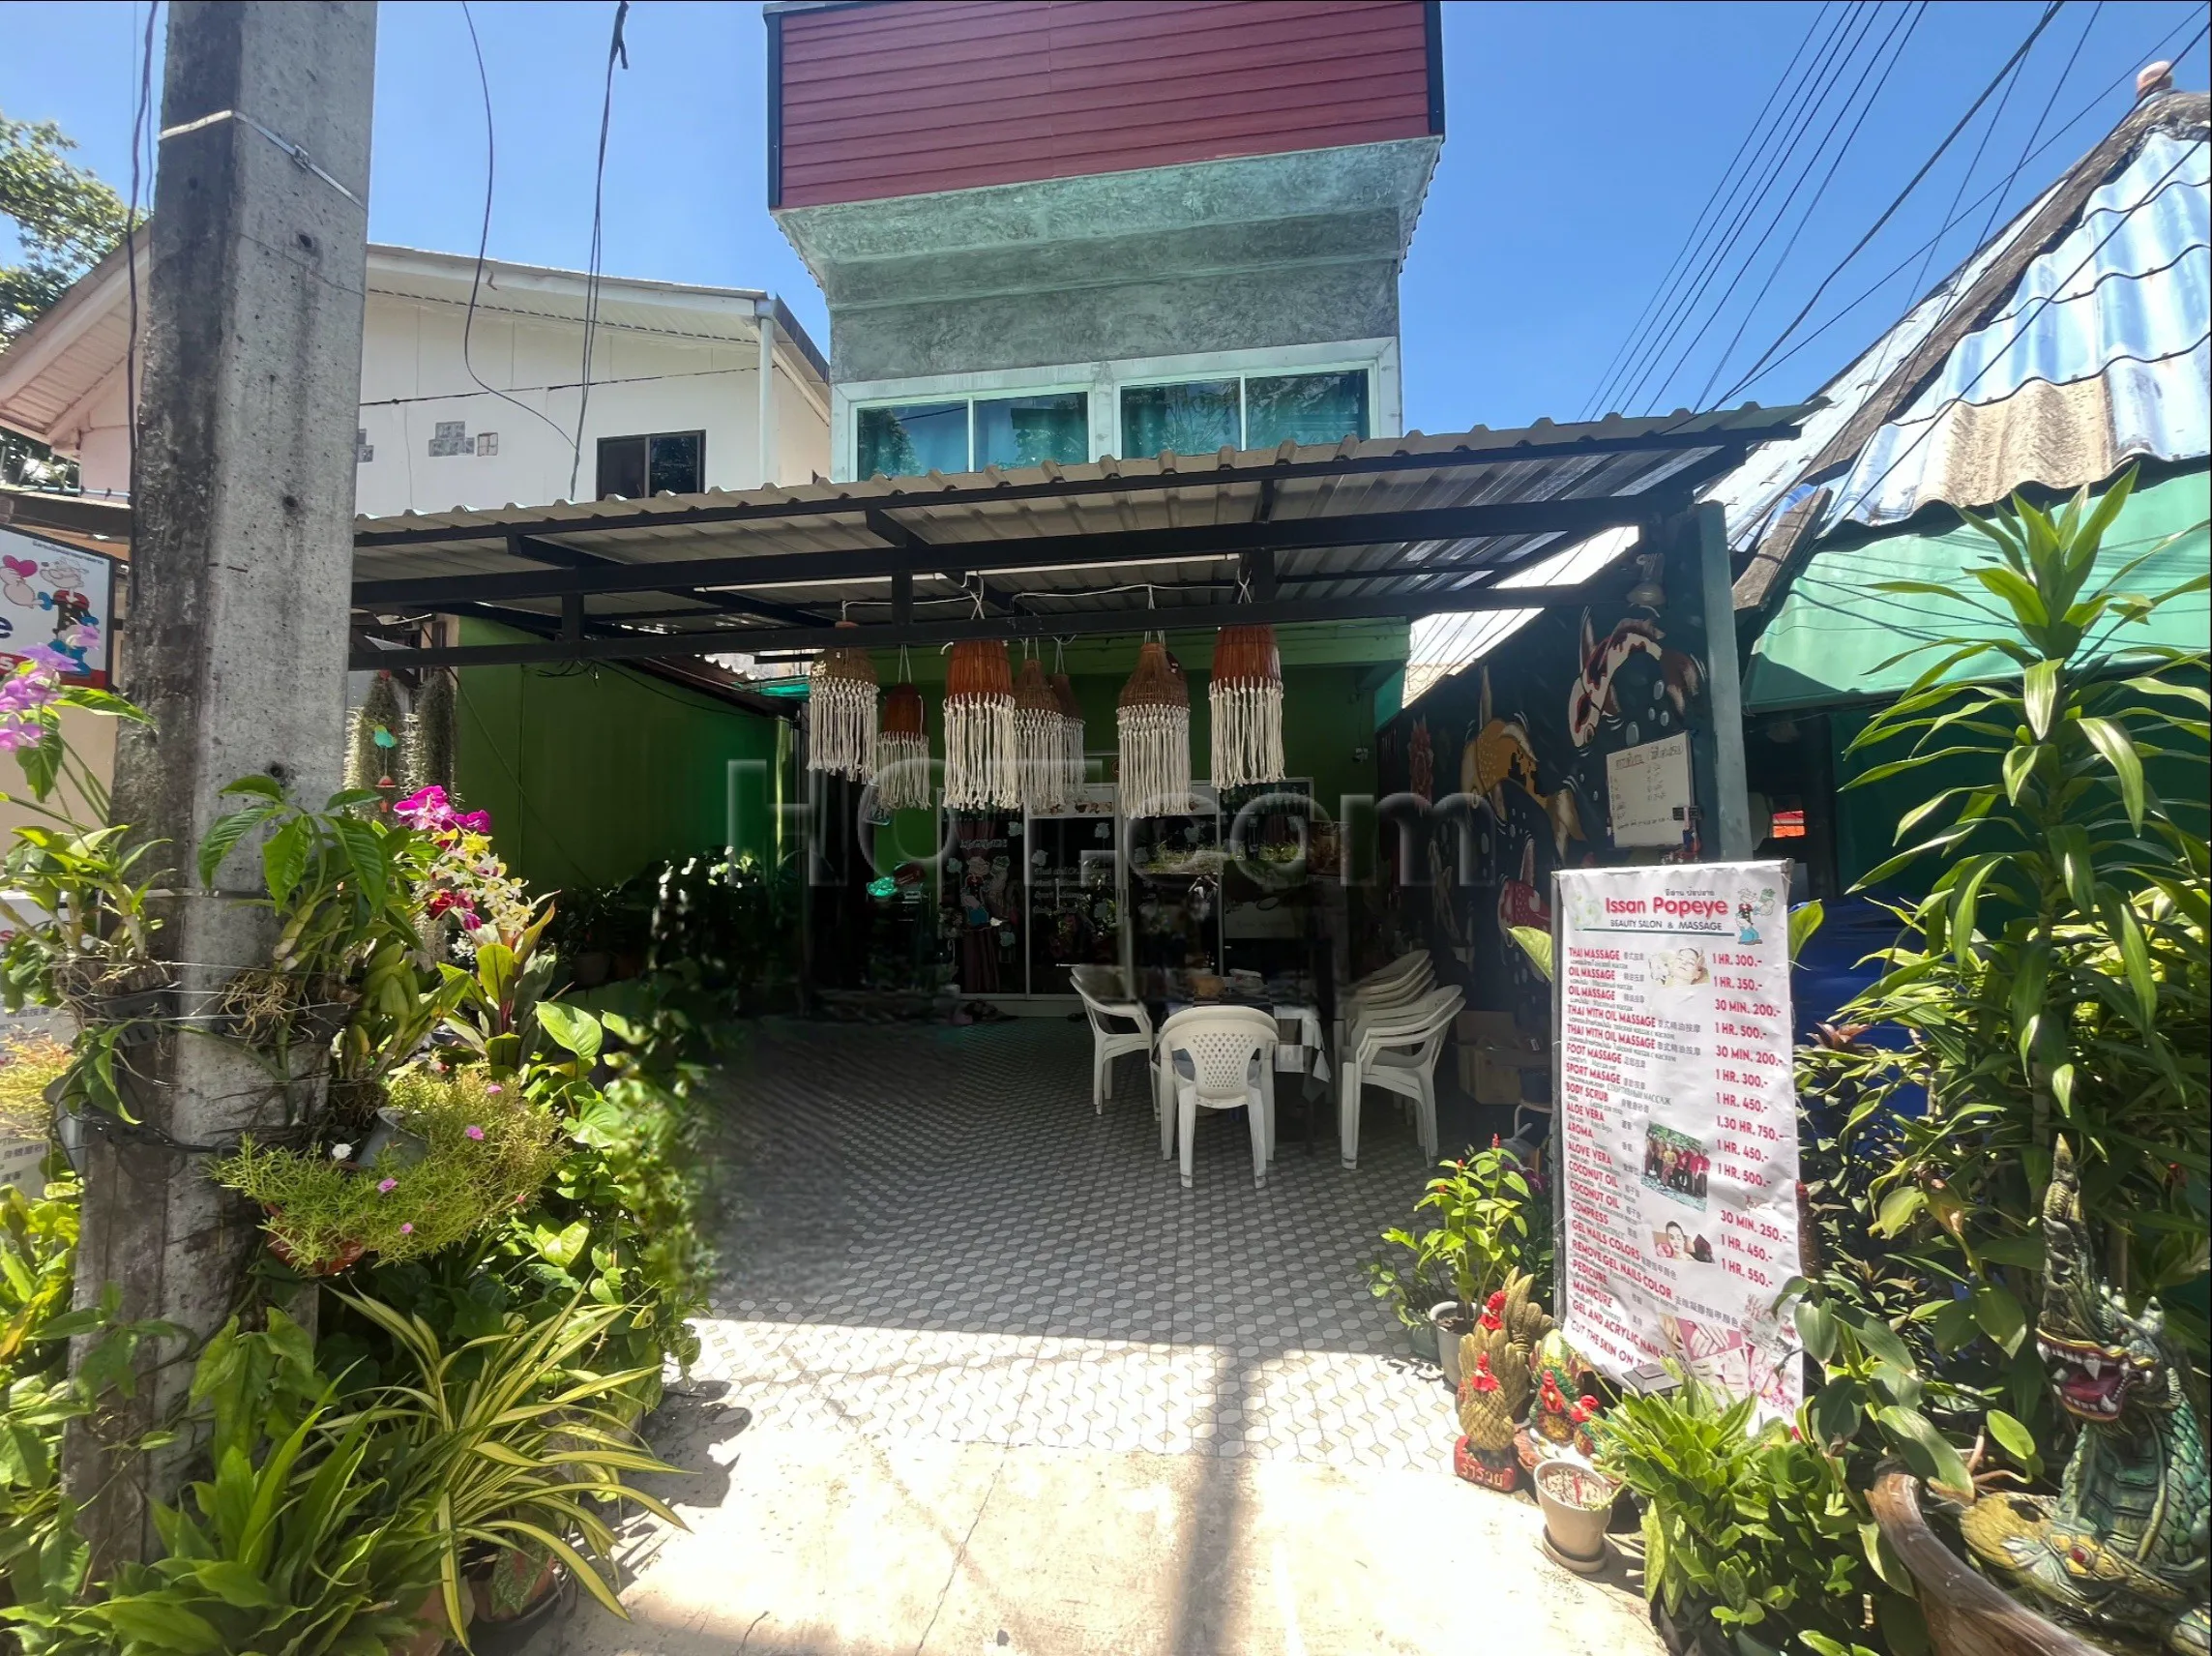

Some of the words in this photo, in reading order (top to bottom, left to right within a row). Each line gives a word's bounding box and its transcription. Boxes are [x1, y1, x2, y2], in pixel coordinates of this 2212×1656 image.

[1606, 897, 1646, 914] Issan
[1653, 897, 1729, 919] Popeye
[1678, 922, 1723, 931] MASSAGE
[1569, 948, 1584, 959] THAI
[1584, 949, 1620, 961] MASSAGE
[1713, 953, 1717, 963] 1
[1719, 954, 1733, 965] HR.
[1735, 955, 1762, 967] 300.-
[1569, 966, 1580, 977] OIL
[1580, 968, 1615, 980] MASSAGE
[1714, 976, 1718, 987] 1
[1720, 977, 1734, 989] HR.
[1737, 978, 1762, 991] 350.-
[1569, 986, 1580, 995] OIL
[1580, 987, 1615, 1000] MASSAGE
[1567, 1004, 1585, 1016] THAI
[1586, 1007, 1604, 1019] WITH
[1606, 1010, 1617, 1021] OIL
[1619, 1012, 1656, 1027] MASSAGE
[1715, 999, 1726, 1011] 30
[1729, 1001, 1751, 1014] MIN.
[1753, 1003, 1782, 1017] 200.-
[1567, 1023, 1584, 1035] THAI
[1586, 1026, 1604, 1039] WITH
[1604, 1029, 1617, 1043] OIL
[1619, 1032, 1656, 1050] MASSAGE
[1716, 1022, 1719, 1033] 1
[1722, 1023, 1738, 1035] HR.
[1741, 1025, 1767, 1040] 500.-
[1567, 1043, 1585, 1056] FOOT
[1587, 1048, 1622, 1064] MASSAGE
[1716, 1045, 1727, 1057] 30
[1731, 1048, 1753, 1062] MIN.
[1756, 1051, 1784, 1066] 200.-
[1567, 1063, 1588, 1076] SPORT
[1590, 1068, 1621, 1084] MASAGE
[1716, 1069, 1720, 1079] 1
[1723, 1070, 1739, 1083] HR.
[1743, 1074, 1768, 1088] 300.-
[1565, 1081, 1583, 1096] BODY
[1584, 1086, 1608, 1102] SCRUB
[1716, 1092, 1720, 1104] 1
[1724, 1093, 1739, 1107] HR.
[1743, 1097, 1768, 1112] 450.-
[1567, 1101, 1584, 1116] ALOE
[1586, 1107, 1605, 1122] VERA
[1567, 1122, 1594, 1138] AROMA
[1717, 1115, 1737, 1130] 1.30
[1739, 1120, 1755, 1136] HR.
[1757, 1125, 1784, 1141] 750.-
[1568, 1141, 1590, 1157] ALOVE
[1592, 1149, 1612, 1165] VERA
[1718, 1139, 1721, 1151] 1
[1724, 1141, 1740, 1155] HR.
[1743, 1145, 1768, 1163] 450.-
[1569, 1161, 1604, 1180] COCONUT
[1606, 1173, 1618, 1188] OIL
[1718, 1163, 1722, 1174] 1
[1725, 1165, 1740, 1180] HR.
[1743, 1170, 1771, 1188] 500.-
[1570, 1180, 1605, 1202] COCONUT
[1606, 1196, 1620, 1209] OIL
[1571, 1199, 1609, 1225] COMPRESS
[1721, 1209, 1733, 1225] 30
[1736, 1216, 1757, 1233] MIN.
[1760, 1223, 1787, 1243] 250.-
[1572, 1219, 1584, 1233] GEL
[1587, 1227, 1607, 1244] NAILS
[1609, 1237, 1640, 1260] COLORS
[1722, 1234, 1725, 1246] 1
[1727, 1237, 1745, 1252] HR.
[1747, 1242, 1772, 1262] 450.-
[1572, 1239, 1604, 1261] REMOVE
[1604, 1254, 1619, 1271] GEL
[1621, 1260, 1642, 1282] NAILS
[1644, 1274, 1672, 1299] COLOR
[1572, 1259, 1607, 1285] PEDICURE
[1722, 1257, 1725, 1270] 1
[1728, 1262, 1745, 1278] HR.
[1748, 1268, 1774, 1288] 550.-
[1573, 1280, 1613, 1308] MANICURE
[1573, 1300, 1587, 1317] GEL
[1588, 1309, 1604, 1324] AND
[1604, 1317, 1638, 1347] ACRYLIC
[1571, 1319, 1585, 1336] CUT
[1586, 1329, 1600, 1346] THE
[1600, 1337, 1617, 1357] SKIN
[1619, 1350, 1634, 1365] ON
